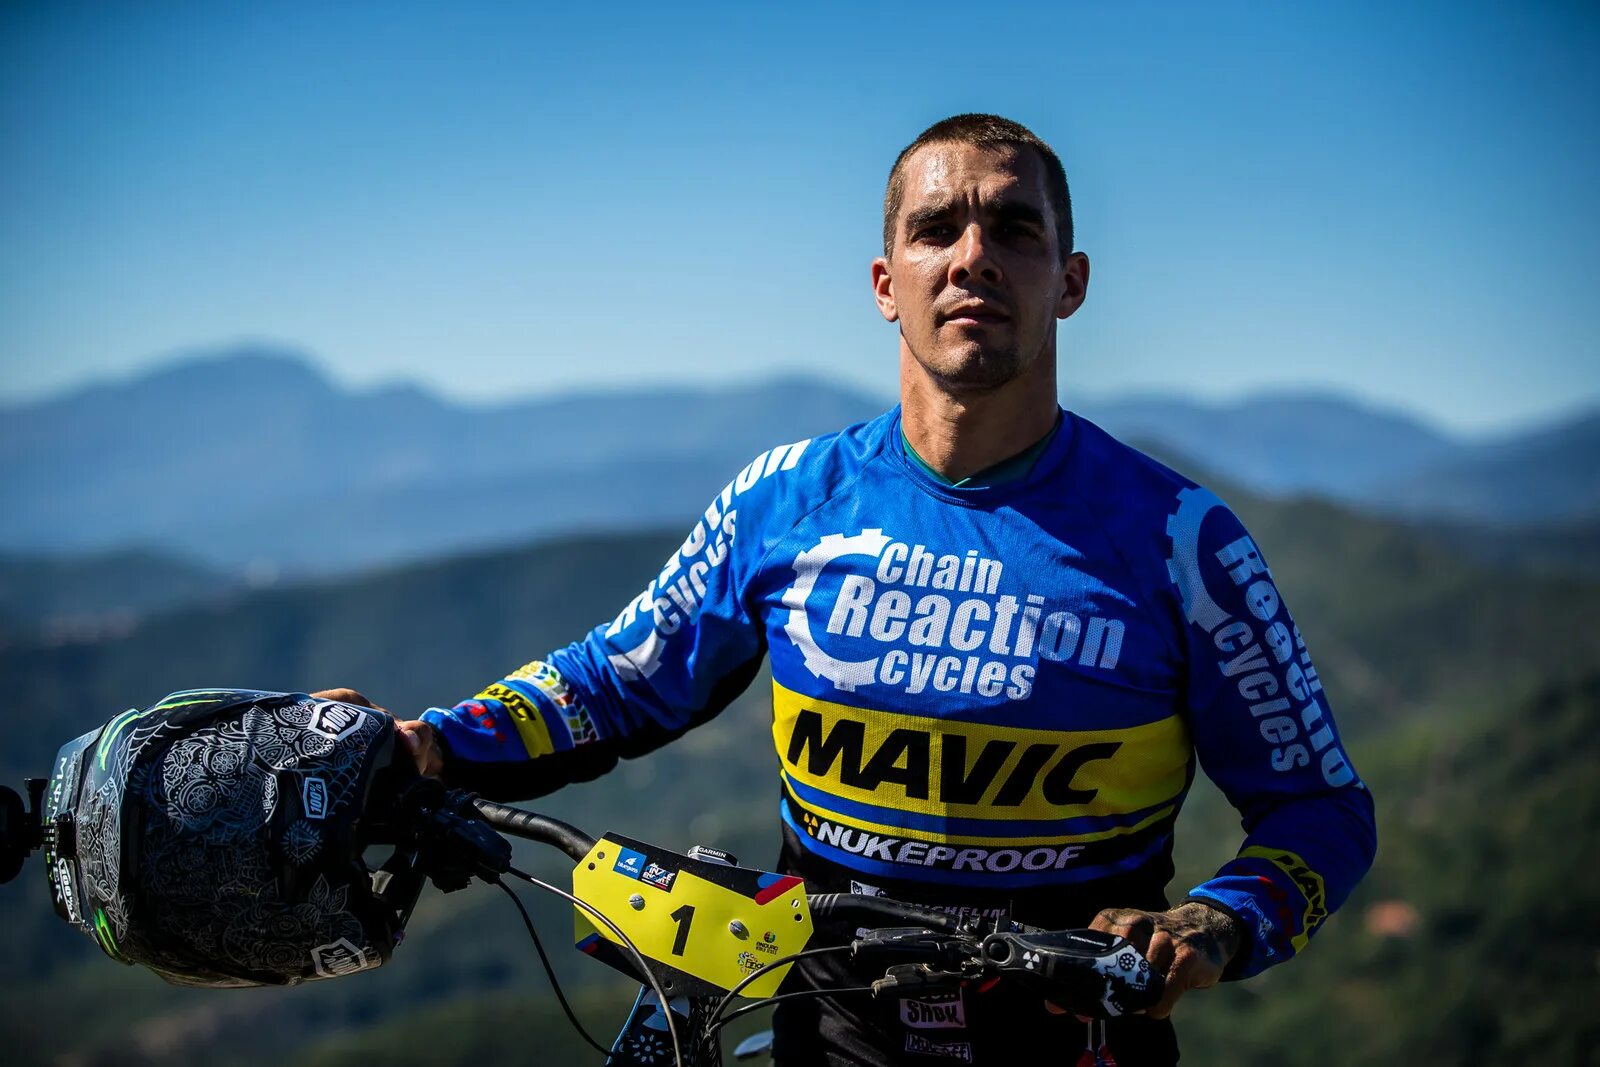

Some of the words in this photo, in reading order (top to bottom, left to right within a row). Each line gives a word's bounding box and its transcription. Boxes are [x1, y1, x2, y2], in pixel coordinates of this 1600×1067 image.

[876, 542, 1003, 595] Chain
[826, 574, 1125, 669] Reaction
[321, 704, 358, 732] 100%
[787, 708, 1123, 807] MAVIC
[310, 783, 322, 812] 100%
[698, 847, 727, 858] GARMIN
[817, 821, 1085, 872] NUKEPROOF
[670, 905, 695, 957] 1
